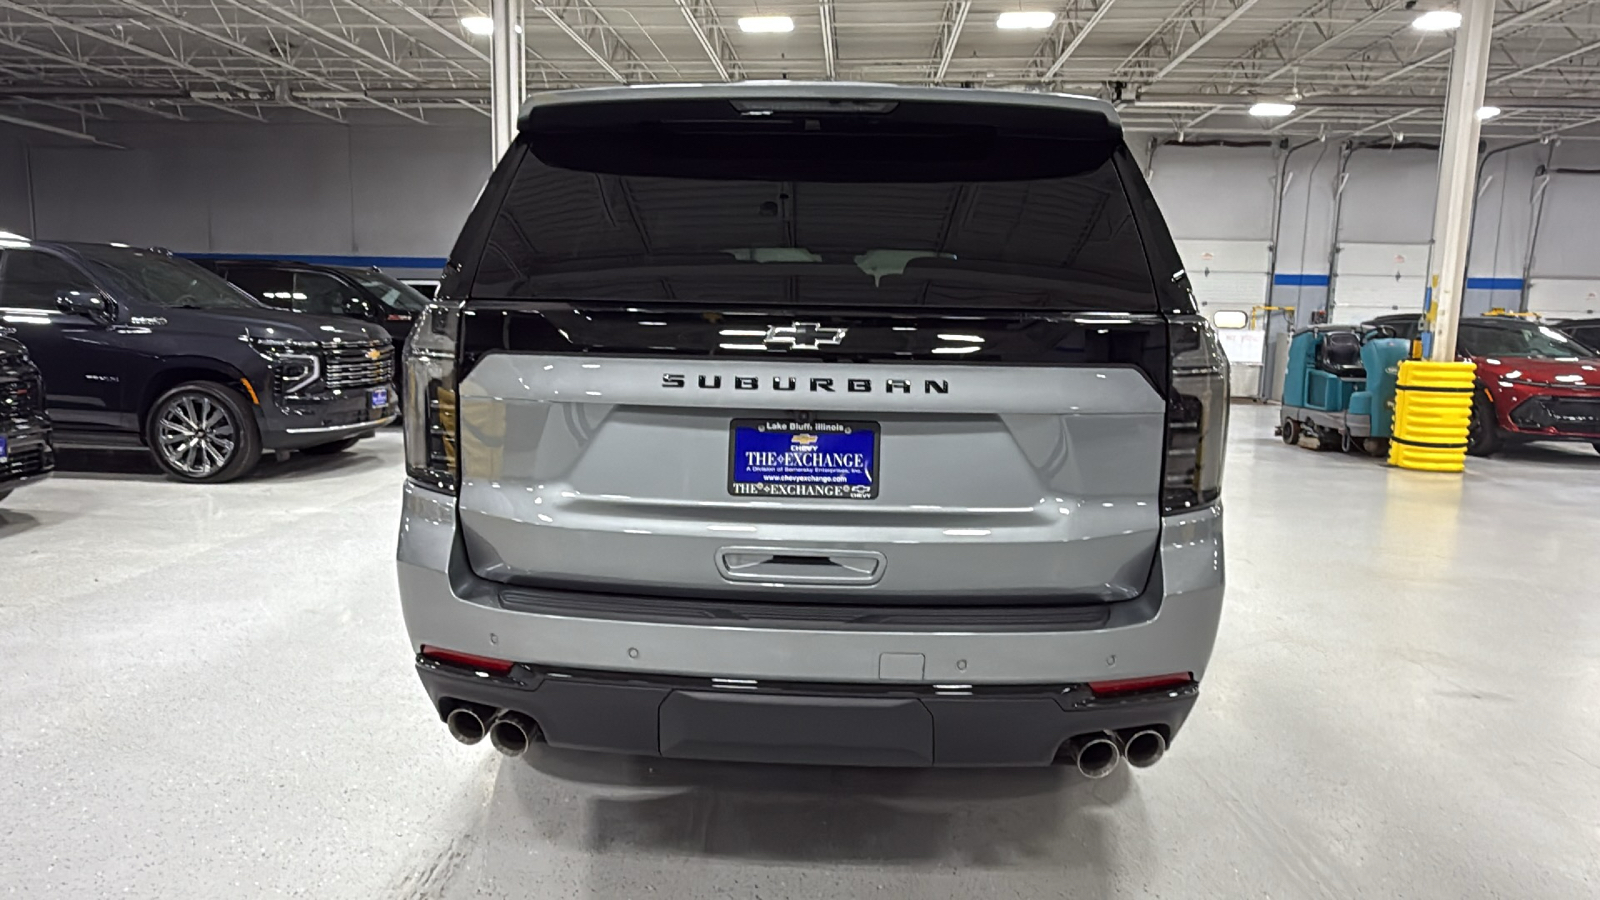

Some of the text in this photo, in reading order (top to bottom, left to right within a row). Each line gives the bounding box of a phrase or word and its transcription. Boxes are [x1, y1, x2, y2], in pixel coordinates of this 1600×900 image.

[662, 373, 949, 394] SUBURBAN
[766, 422, 788, 431] Lake
[815, 423, 844, 431] Illinois
[784, 452, 864, 468] EXCHANGE
[763, 475, 847, 484] www.chevyexchange.com
[770, 484, 844, 496] EXCHANGE
